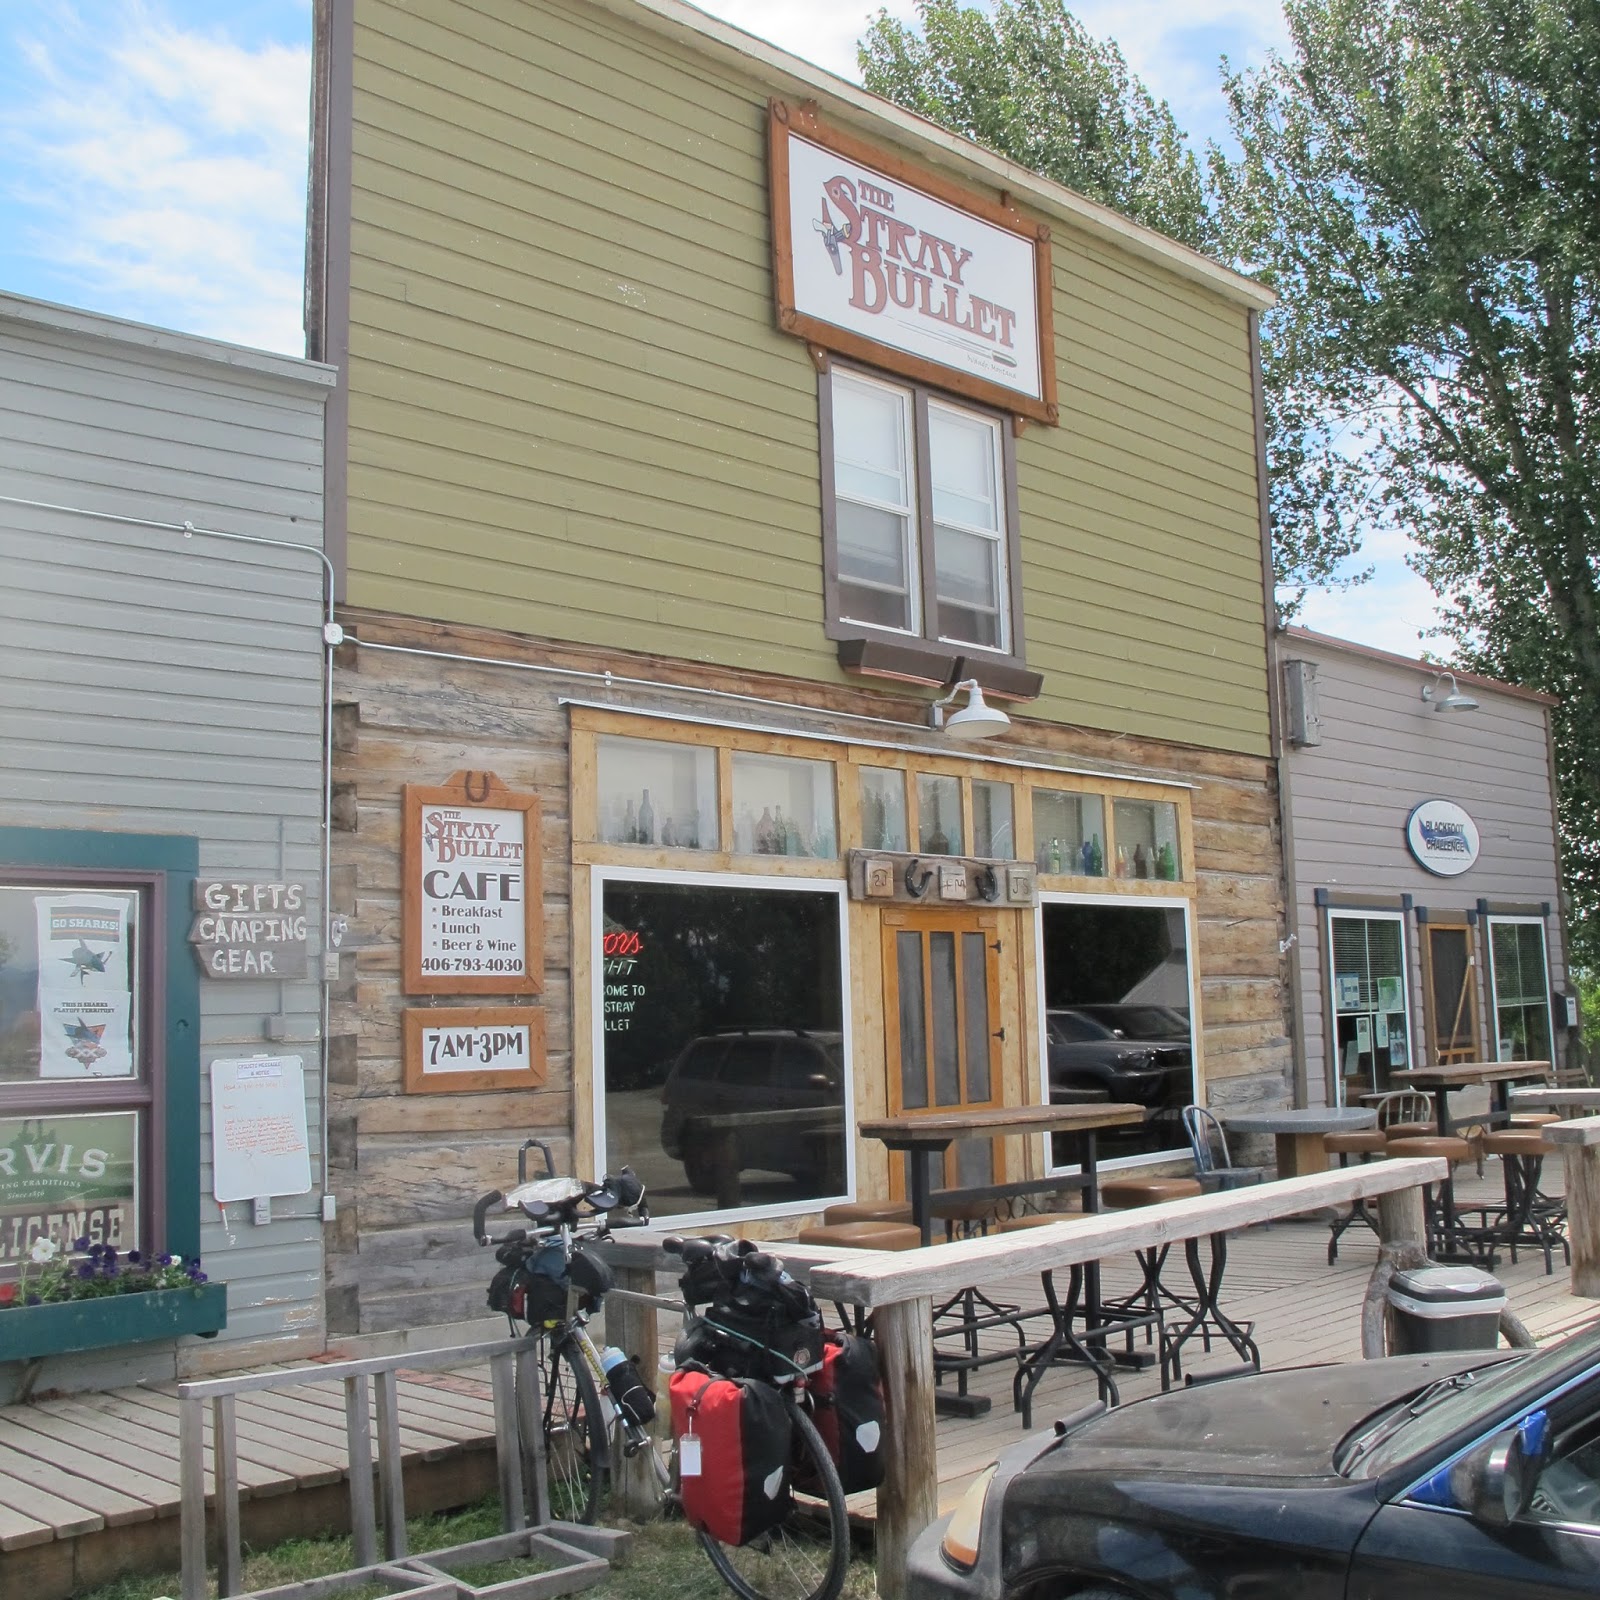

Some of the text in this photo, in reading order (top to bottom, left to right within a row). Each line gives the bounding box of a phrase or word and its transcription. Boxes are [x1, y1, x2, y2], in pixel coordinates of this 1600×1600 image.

[857, 179, 894, 212] THE
[821, 175, 973, 286] STRAY
[849, 247, 1016, 348] BULLET
[443, 810, 461, 819] THE
[425, 812, 501, 840] STRAY
[1425, 820, 1465, 833] BLACKFOOT
[437, 837, 523, 863] BULLET
[1425, 839, 1465, 852] CHALLENGE
[423, 869, 520, 902] CAFE
[205, 883, 303, 911] GIFTS
[442, 904, 503, 918] Breakfast
[52, 918, 119, 930] GO SHARKS!
[200, 916, 307, 943] CAMPING
[442, 921, 480, 934] Lunch
[442, 939, 517, 951] Beer & Wine
[212, 949, 277, 974] GEAR
[422, 957, 523, 972] 406-793-4030
[603, 957, 638, 975] HT
[632, 985, 646, 996] TO
[604, 1001, 635, 1013] STRAY
[604, 1019, 630, 1031] LLET
[429, 1031, 523, 1065] 7AM-3PM
[22, 1179, 81, 1188] TRADITIONS
